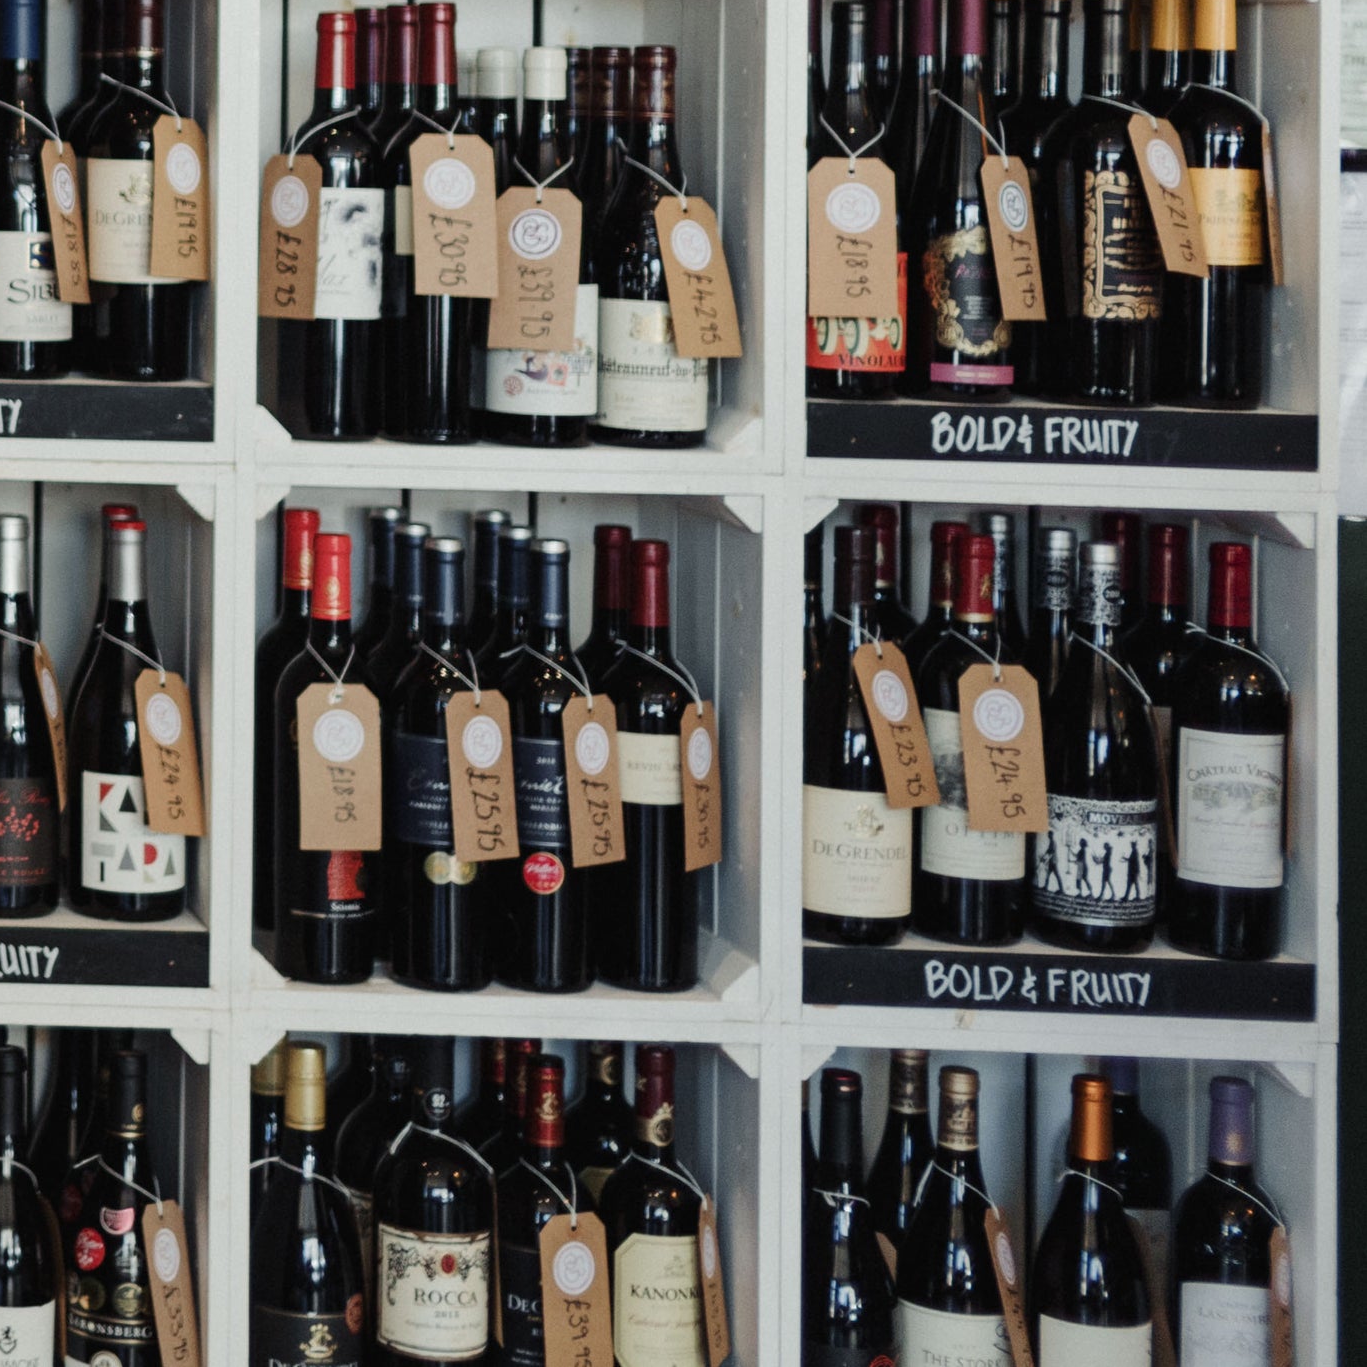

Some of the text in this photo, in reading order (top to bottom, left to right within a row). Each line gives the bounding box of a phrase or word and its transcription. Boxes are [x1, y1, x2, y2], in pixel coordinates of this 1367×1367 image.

[931, 412, 1138, 456] BOLD & FRUITY
[925, 960, 1150, 1006] BOLD & FRUITY
[414, 1287, 478, 1308] ROCCA
